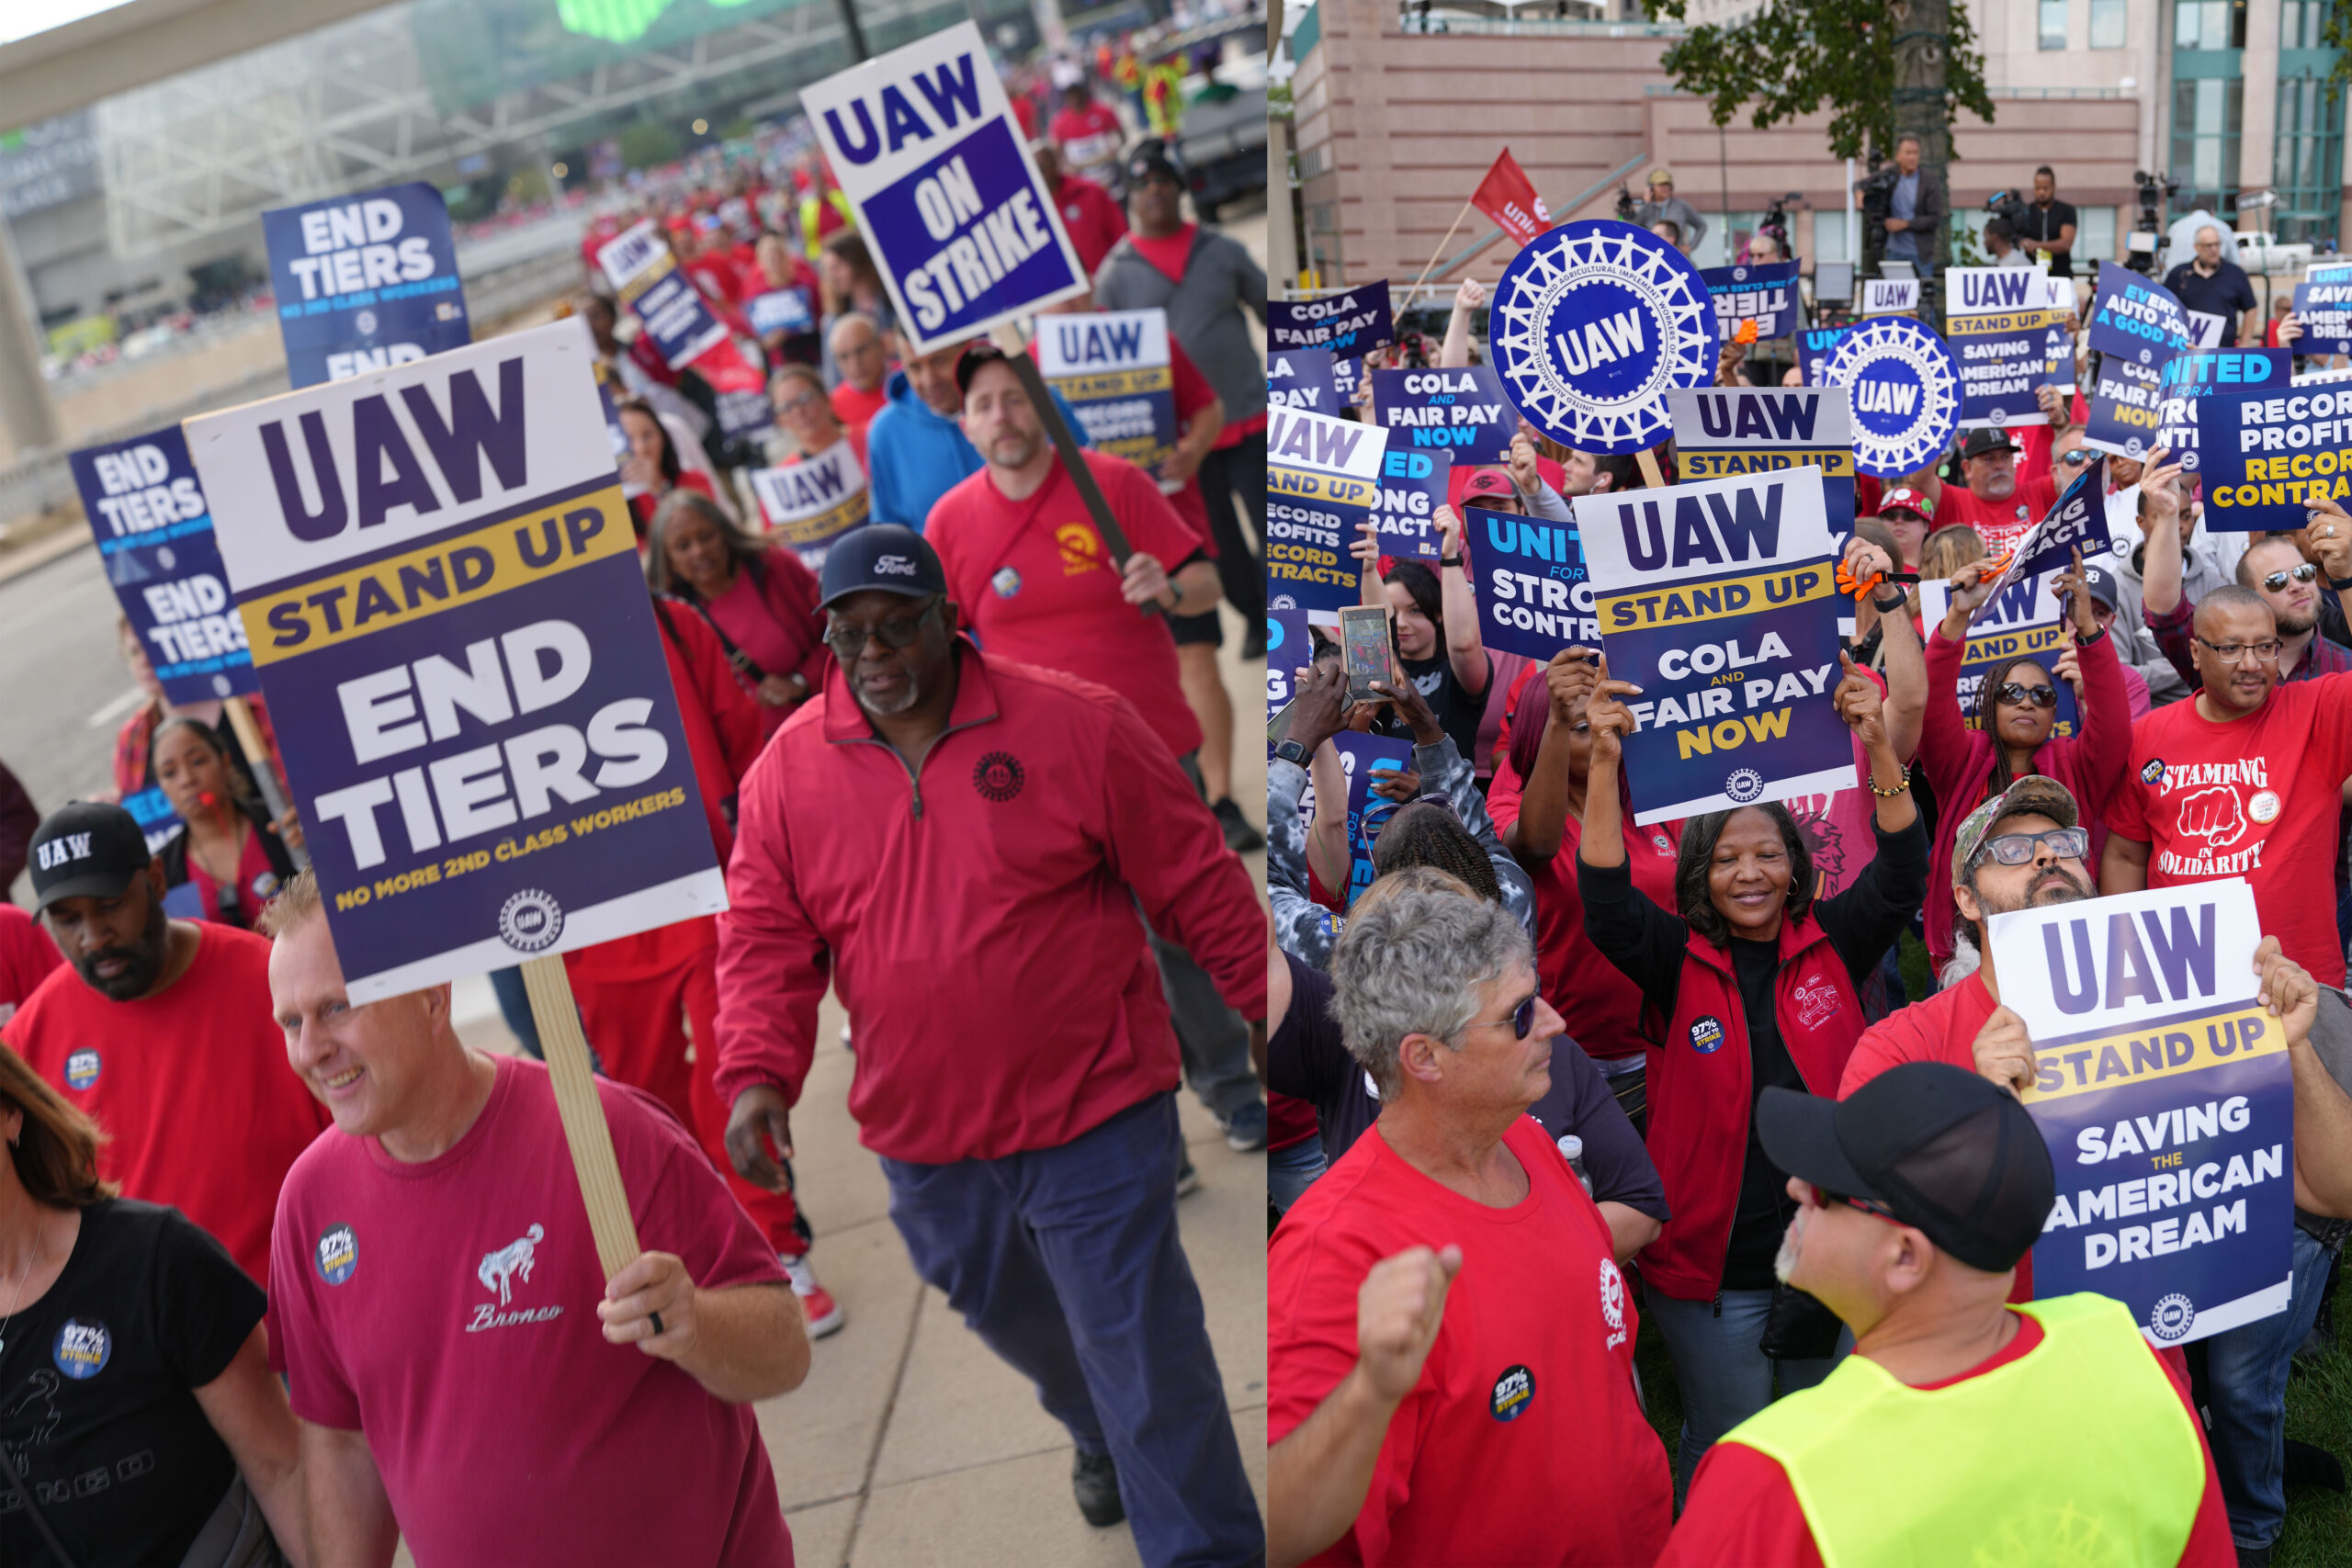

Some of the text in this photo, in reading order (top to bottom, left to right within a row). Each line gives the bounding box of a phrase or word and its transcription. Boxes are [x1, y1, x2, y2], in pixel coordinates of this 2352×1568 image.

[823, 52, 982, 165] UAW
[914, 154, 984, 242] ON
[300, 198, 403, 255] END
[288, 236, 435, 300] TIERS
[904, 186, 1051, 331] STRIKE
[1559, 265, 1617, 284] AGRICULTURAL
[1619, 269, 1659, 300] IMPLEMENT
[1730, 282, 1764, 293] CLASS
[1962, 273, 2030, 306] UAW
[1544, 283, 1558, 299] AND
[1875, 284, 1911, 307] UAW
[2124, 283, 2178, 317] EVERY
[1291, 295, 1358, 321] COLA
[1315, 315, 1340, 328] AND
[1532, 300, 1545, 346] AEROSPACE
[1658, 301, 1676, 341] WORKERS
[1953, 314, 2041, 332] STAND UP
[2105, 294, 2158, 324] AUTO
[1274, 310, 1378, 344] FAIR PAY
[1301, 331, 1357, 352] OW
[1555, 307, 1645, 376] UAW
[2096, 309, 2110, 325] A
[2114, 314, 2165, 343] GOOD
[1059, 322, 1142, 364] UAW
[1669, 344, 1676, 355] OF
[1963, 340, 2030, 359] SAVING
[1404, 373, 1478, 394] COLA
[1653, 359, 1673, 391] AMERICA
[1965, 378, 2030, 397] DREAM
[1269, 387, 1320, 409] PAY
[1428, 394, 1455, 405] AND
[1566, 397, 1595, 413] UNITED
[1858, 379, 1919, 415] UAW
[2098, 378, 2147, 406] FAIR
[2175, 386, 2213, 397] FOR A
[1387, 404, 1502, 426] FAIR PAY
[1697, 394, 1819, 441] UAW
[259, 355, 527, 544] UAW
[1413, 426, 1477, 446] NOW
[94, 444, 170, 496] END
[1689, 455, 1843, 474] STAND UP
[770, 457, 843, 512] UAW
[1329, 480, 1364, 501] UP
[2212, 476, 2351, 508] CONTRA
[96, 477, 206, 537] TIERS
[1617, 483, 1783, 572] UAW
[266, 506, 605, 647] STAND UP
[874, 554, 918, 576] Ford
[1550, 566, 1585, 580] FOR
[142, 573, 227, 625] END
[1612, 571, 1819, 627] STAND UP
[1493, 603, 1602, 641] CONTR
[2026, 630, 2059, 648] UP
[1657, 631, 1792, 681] COLA
[337, 620, 592, 765] END
[1711, 671, 1745, 686] AND
[1629, 662, 1833, 733] FAIR PAY
[1676, 706, 1792, 761] NOW
[314, 697, 668, 871] TIERS
[1736, 779, 1752, 790] UAW
[37, 831, 92, 871] UAW
[335, 786, 686, 912] NO MORE 2ND CLASS WORKERS
[2157, 840, 2266, 875] SOLIDARITY
[2198, 847, 2212, 858] IN
[2041, 903, 2216, 1015] UAW
[1691, 1018, 1717, 1036] 97%
[1694, 1031, 1711, 1042] READY
[1696, 1032, 1721, 1047] STRIKE
[2037, 1016, 2266, 1093] STAND UP
[2076, 1096, 2251, 1165] SAVING
[2151, 1151, 2183, 1170] THE
[2040, 1145, 2283, 1233] AMERICAN
[320, 1226, 351, 1257] 97%
[2085, 1199, 2246, 1270] DREAM
[466, 1303, 563, 1333] Bronco
[2164, 1309, 2181, 1323] UAW
[63, 1324, 105, 1344] 97%
[1496, 1368, 1527, 1397] 97%
[1497, 1388, 1530, 1414] STRIKE
